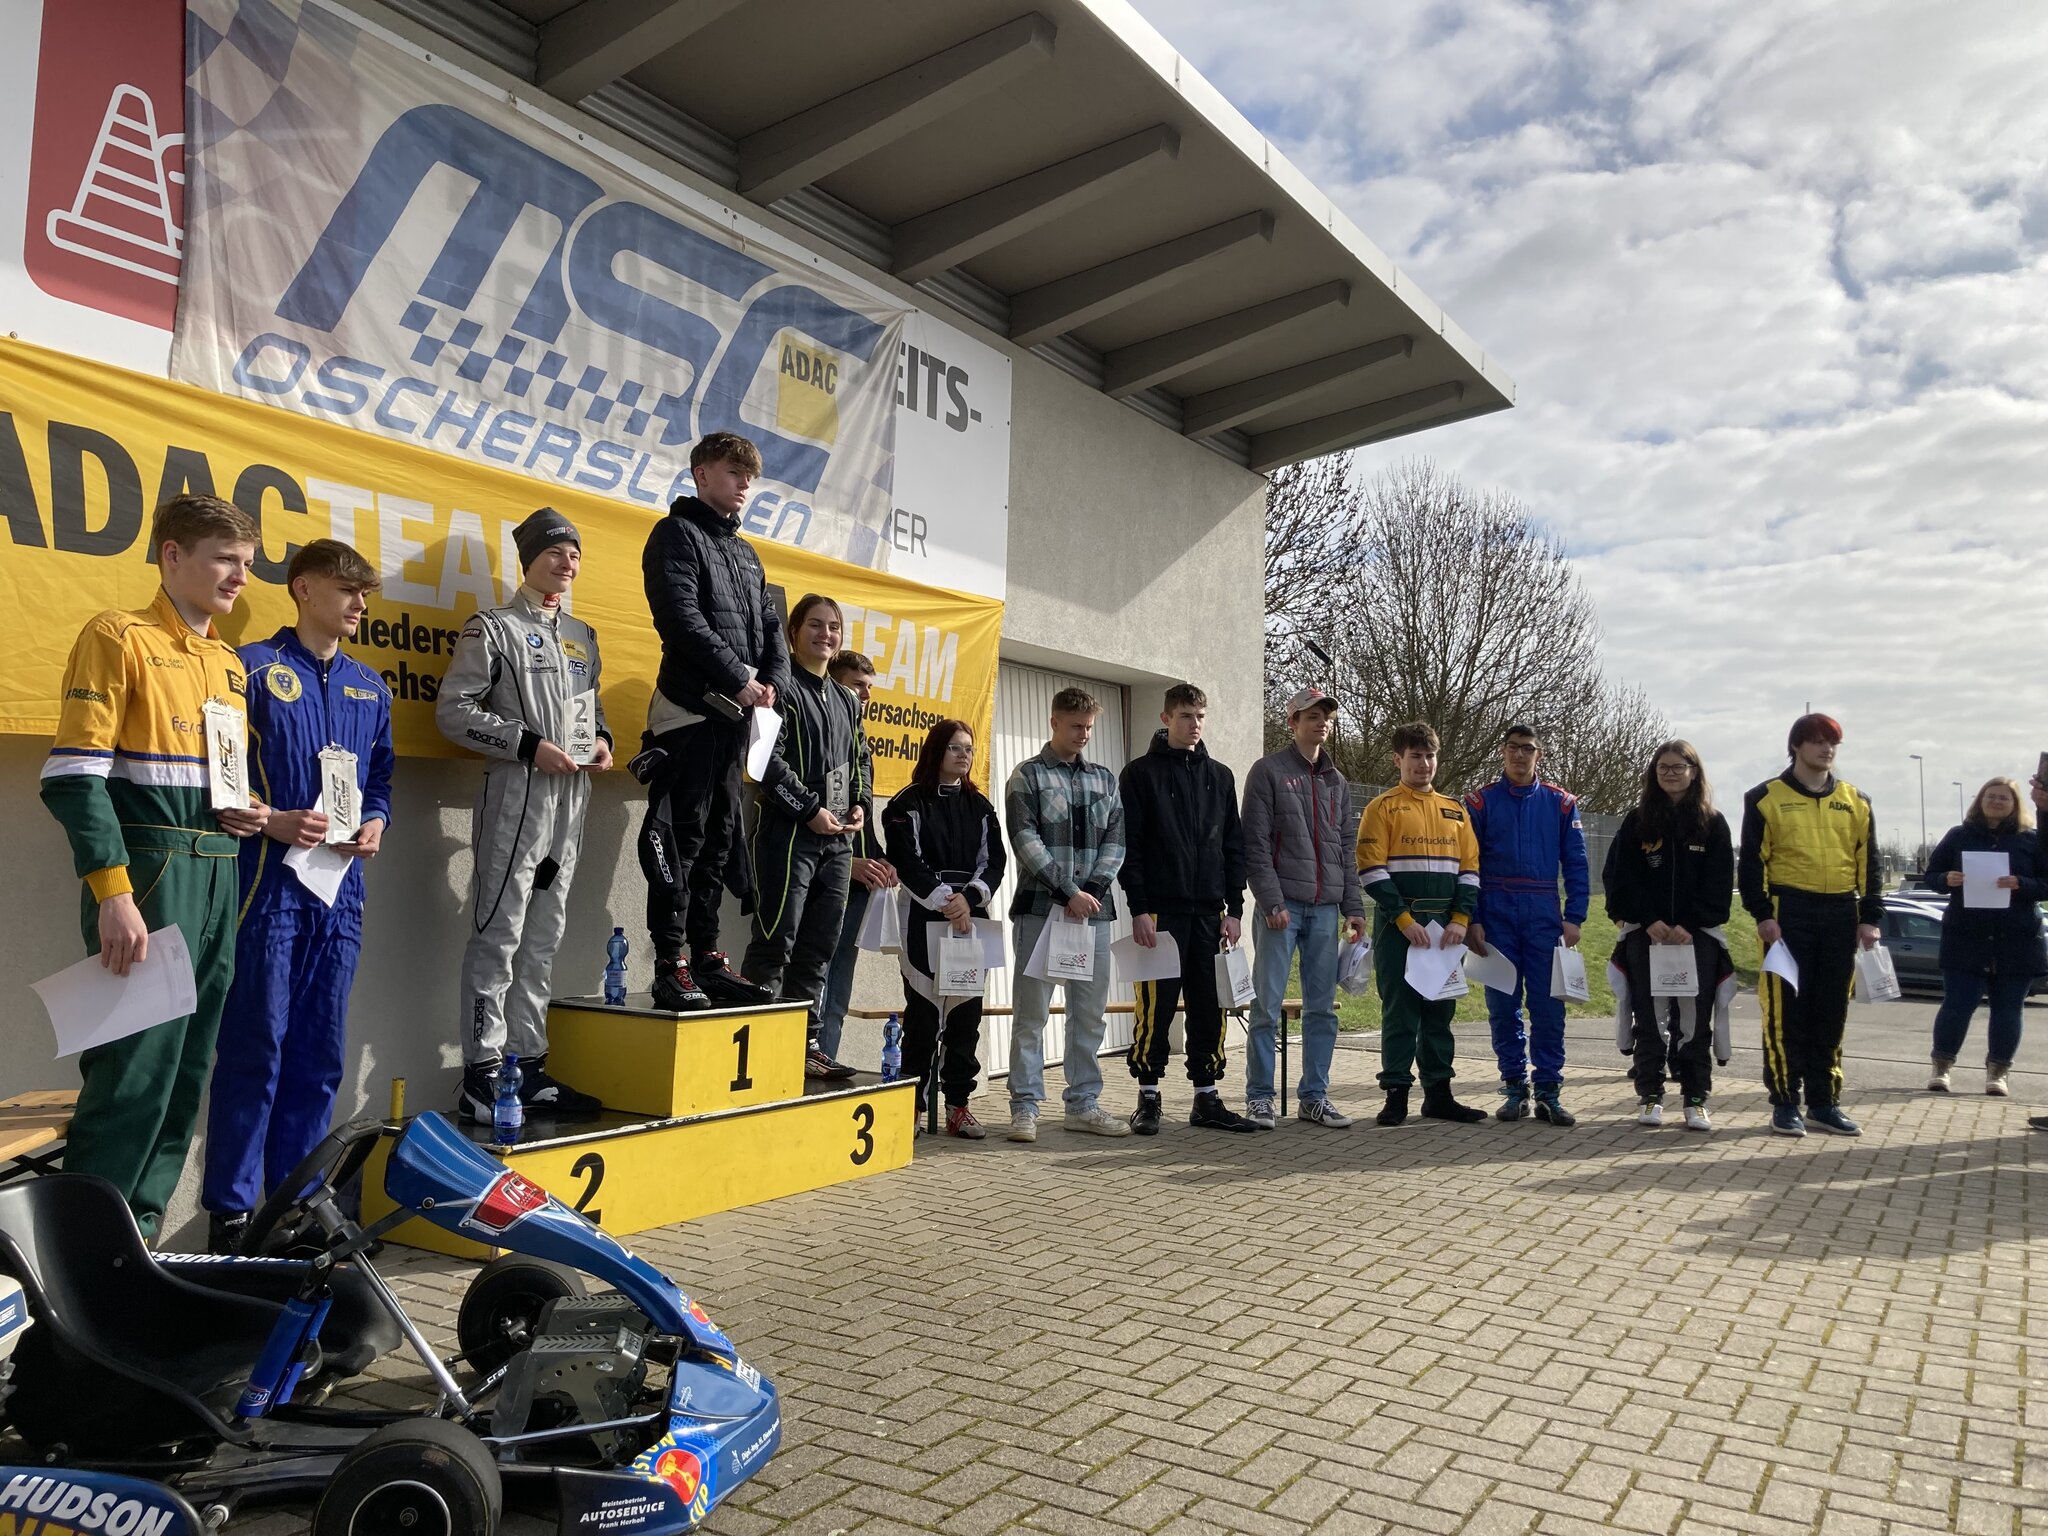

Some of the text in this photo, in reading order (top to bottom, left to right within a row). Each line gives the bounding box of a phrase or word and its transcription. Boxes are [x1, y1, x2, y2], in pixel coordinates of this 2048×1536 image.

[275, 103, 888, 494] MSC
[781, 344, 838, 395] ADAC
[232, 333, 812, 545] OSCHERSLEEN
[892, 507, 928, 558] ER
[573, 698, 588, 723] 2
[466, 728, 509, 750] sparco
[775, 784, 804, 812] sparco
[833, 770, 843, 792] 3
[474, 998, 485, 1042] sparco
[729, 1024, 753, 1092] 1
[849, 1102, 874, 1166] 3
[569, 1151, 605, 1225] 2
[0, 1474, 174, 1536] HUDSON
[580, 1501, 665, 1522] AUTOSERVICE
[601, 1496, 647, 1508] Meisterbetrieb
[689, 1482, 709, 1525] CUP
[599, 1521, 619, 1530] Frank
